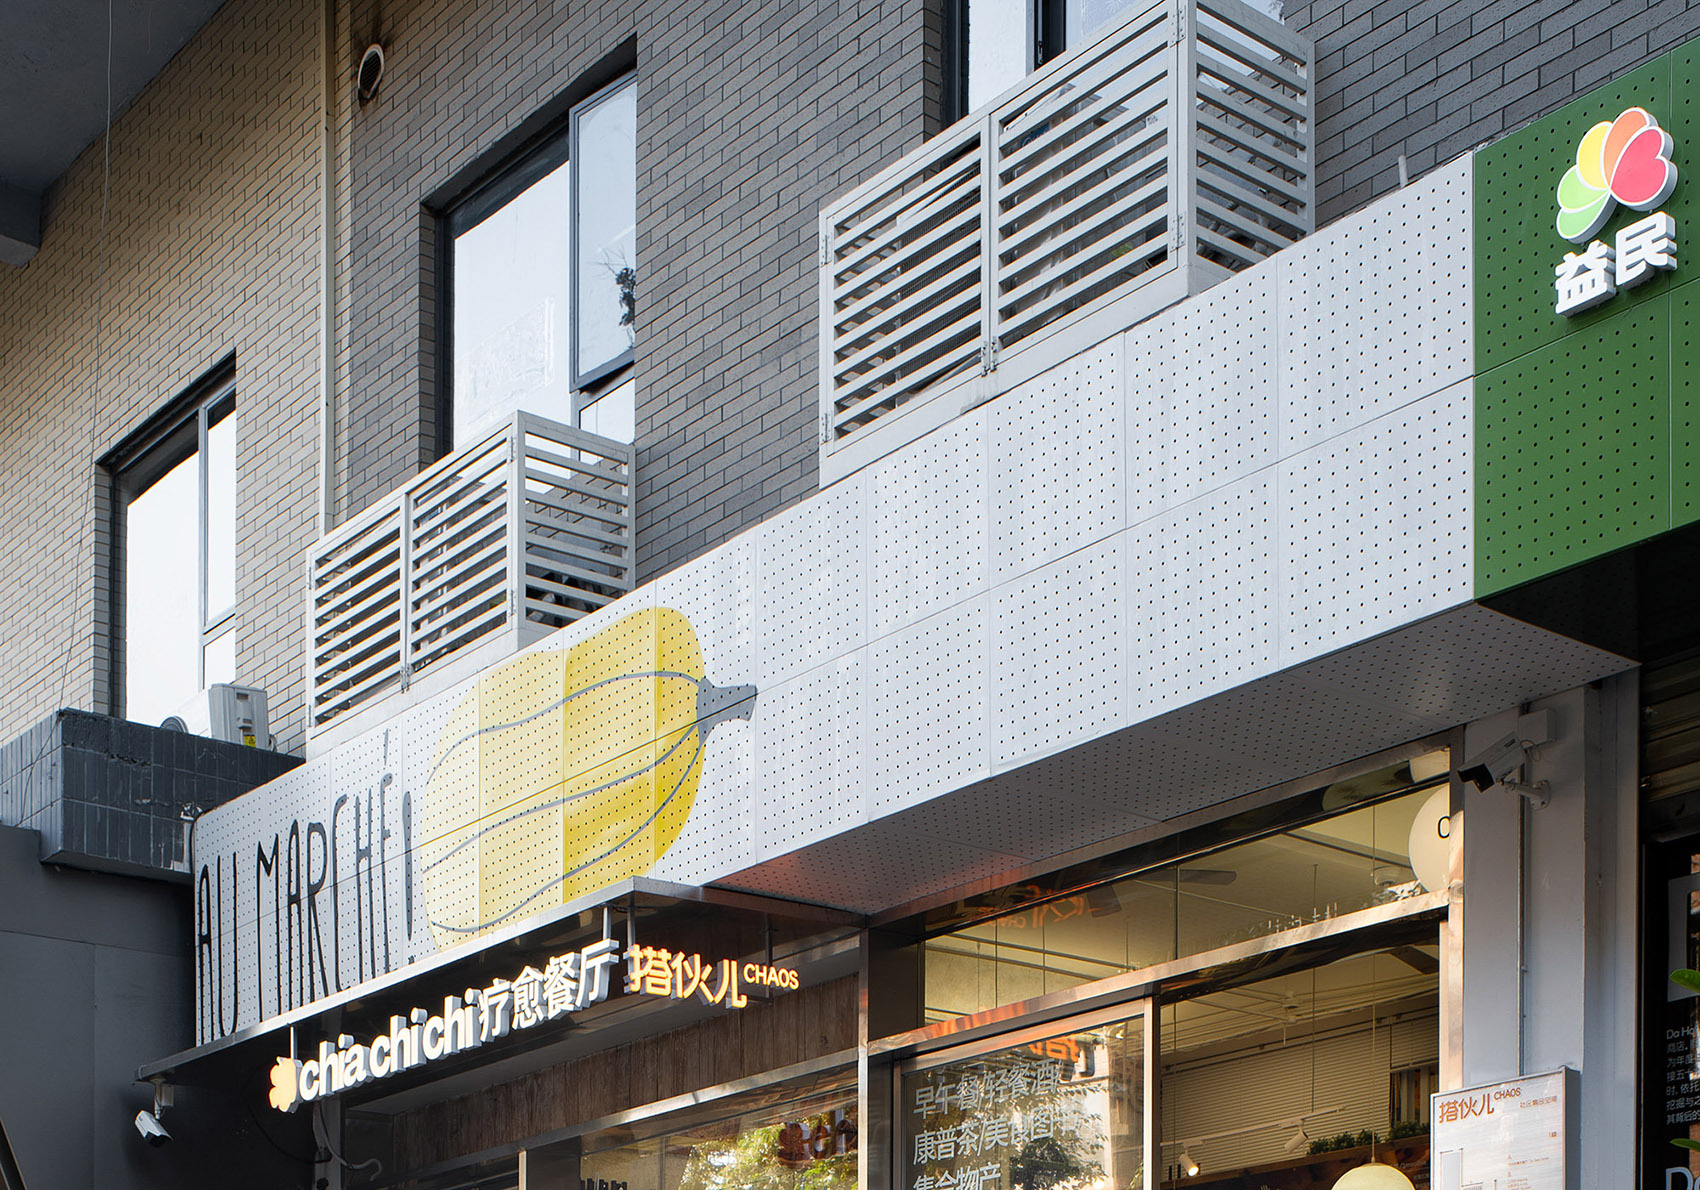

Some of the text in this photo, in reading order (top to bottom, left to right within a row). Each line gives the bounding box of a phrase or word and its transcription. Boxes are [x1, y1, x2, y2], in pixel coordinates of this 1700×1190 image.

[1555, 211, 1674, 315] 益民
[200, 851, 238, 1046] AU
[479, 938, 614, 1043] 疗愈餐厅
[628, 943, 799, 1009] 搭伙儿 CHAOS
[1439, 1087, 1521, 1124] 搭伙儿 CHAOS
